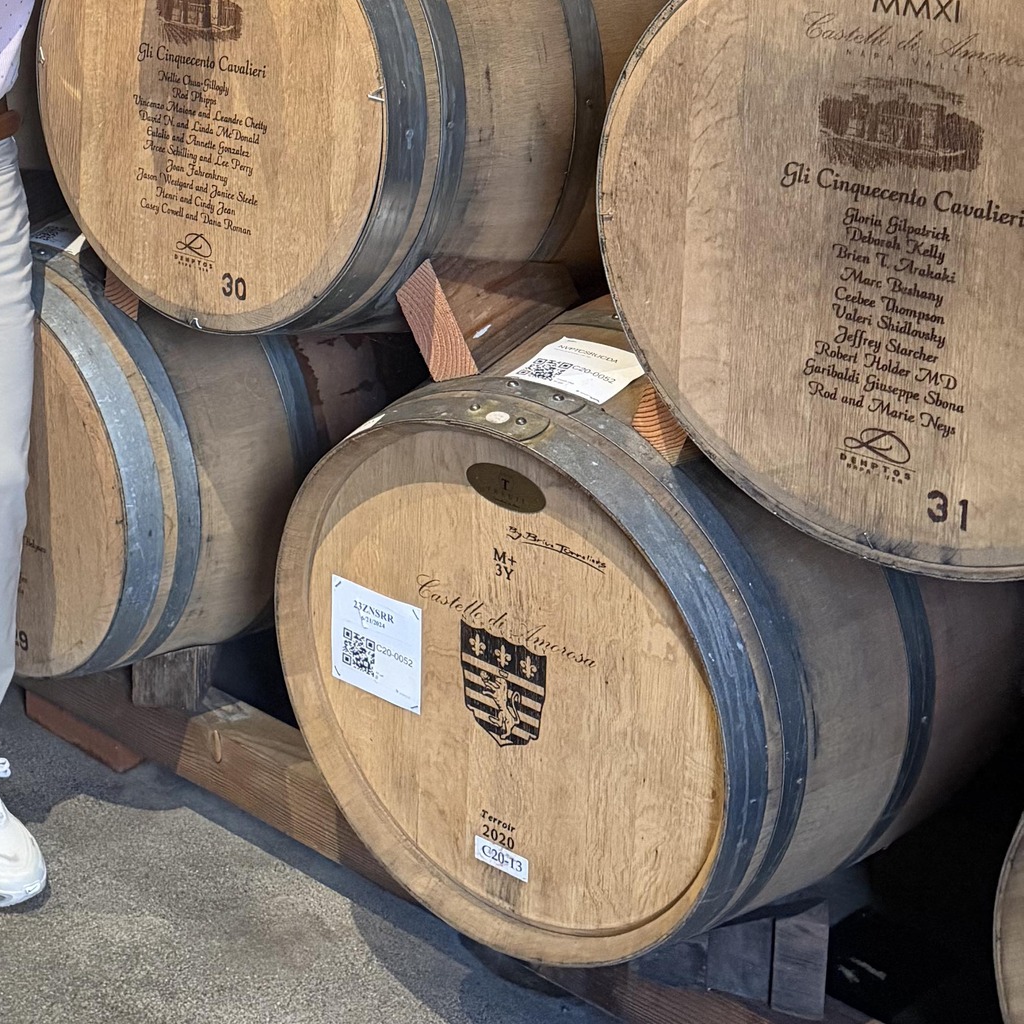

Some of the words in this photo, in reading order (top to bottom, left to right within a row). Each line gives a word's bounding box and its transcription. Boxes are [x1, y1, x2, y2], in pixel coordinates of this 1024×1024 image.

[804, 10, 894, 47] Castello
[897, 29, 923, 51] di
[137, 42, 153, 62] Gli
[156, 45, 215, 69] Cinquecento
[219, 56, 266, 78] Cavalieri
[158, 70, 181, 84] Nellie
[133, 94, 165, 109] Vincenzo
[197, 108, 211, 119] and
[212, 110, 243, 126] Leandre
[245, 116, 268, 134] Chetty
[172, 87, 188, 99] Rod
[191, 91, 217, 108] Phipps
[139, 109, 161, 123] David
[163, 115, 175, 127] N.
[176, 119, 189, 130] and
[191, 121, 214, 135] Linda
[216, 125, 260, 145] McDonald
[186, 163, 228, 186] Fahrenkrug
[156, 186, 178, 201] Henri
[180, 194, 193, 205] and
[194, 196, 215, 214] Cindy
[217, 201, 236, 216] Jean
[780, 161, 810, 188] Gli
[816, 167, 927, 208] Cinquecento
[933, 190, 1024, 228] Cavalieri
[140, 198, 160, 215] Casey
[185, 211, 198, 222] and
[200, 212, 222, 228] Dana
[223, 218, 252, 236] Roman
[842, 207, 882, 227] Gloria
[886, 216, 951, 242] Gilpatrick
[832, 243, 870, 264] Brien
[876, 252, 890, 269] T.
[894, 258, 957, 284] Arakaki
[845, 226, 900, 252] Deborah
[905, 238, 945, 265] Kelly
[222, 272, 247, 301] 30
[840, 266, 882, 289] Marc
[834, 286, 876, 308] Ceebee
[881, 295, 945, 325] Thompson
[832, 303, 873, 326] Valeri
[877, 315, 946, 349] Shidlovsky
[834, 325, 882, 353] Jeffrey
[885, 339, 939, 364] Starcher
[814, 340, 858, 364] Robert
[863, 353, 911, 378] Holder
[914, 367, 957, 391] MD
[803, 357, 861, 384] Garibaldi
[863, 374, 920, 404] Giuseppe
[924, 390, 964, 414] Sbona
[808, 380, 837, 401] Rod
[841, 394, 864, 408] and
[868, 398, 915, 423] Marie
[919, 412, 956, 436] Neys
[927, 489, 969, 532] 31
[493, 547, 517, 567] M+
[495, 564, 514, 581] 3Y
[416, 573, 484, 620] Castello
[489, 612, 508, 629] di
[511, 621, 597, 669] Amorosa
[376, 643, 414, 668] C20-0052
[481, 809, 515, 832] Terroir
[482, 824, 515, 850] 2020
[481, 844, 522, 872] C20-13
